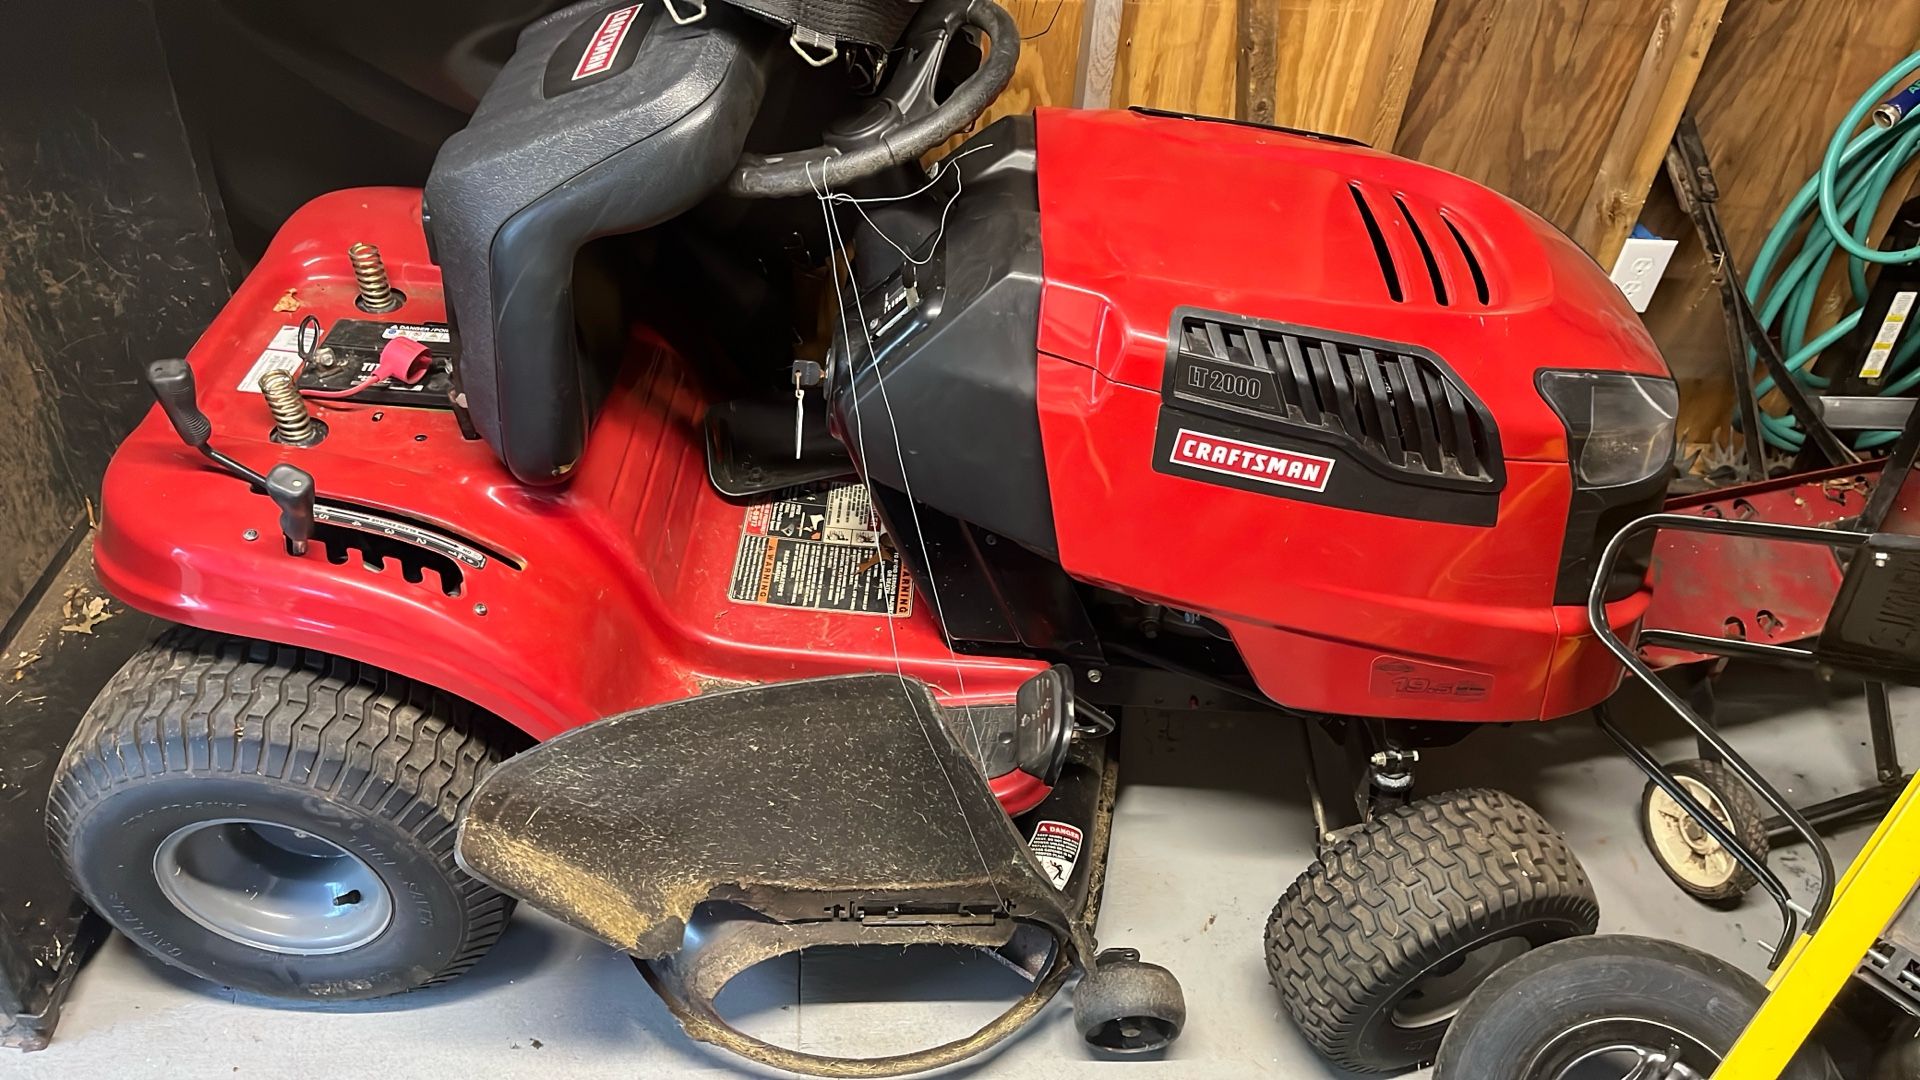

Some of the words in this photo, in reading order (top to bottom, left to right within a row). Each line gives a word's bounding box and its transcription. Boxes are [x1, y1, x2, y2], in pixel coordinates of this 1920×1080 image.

[583, 8, 633, 73] CRAFTSMAN
[1187, 364, 1209, 389] LT
[1209, 370, 1262, 400] 2000
[1182, 439, 1321, 482] CRAFTSMAN
[384, 527, 395, 535] 3
[416, 537, 427, 545] 2
[760, 554, 775, 597] WARNING
[898, 565, 911, 613] ARNING
[1049, 826, 1080, 841] DANGER
